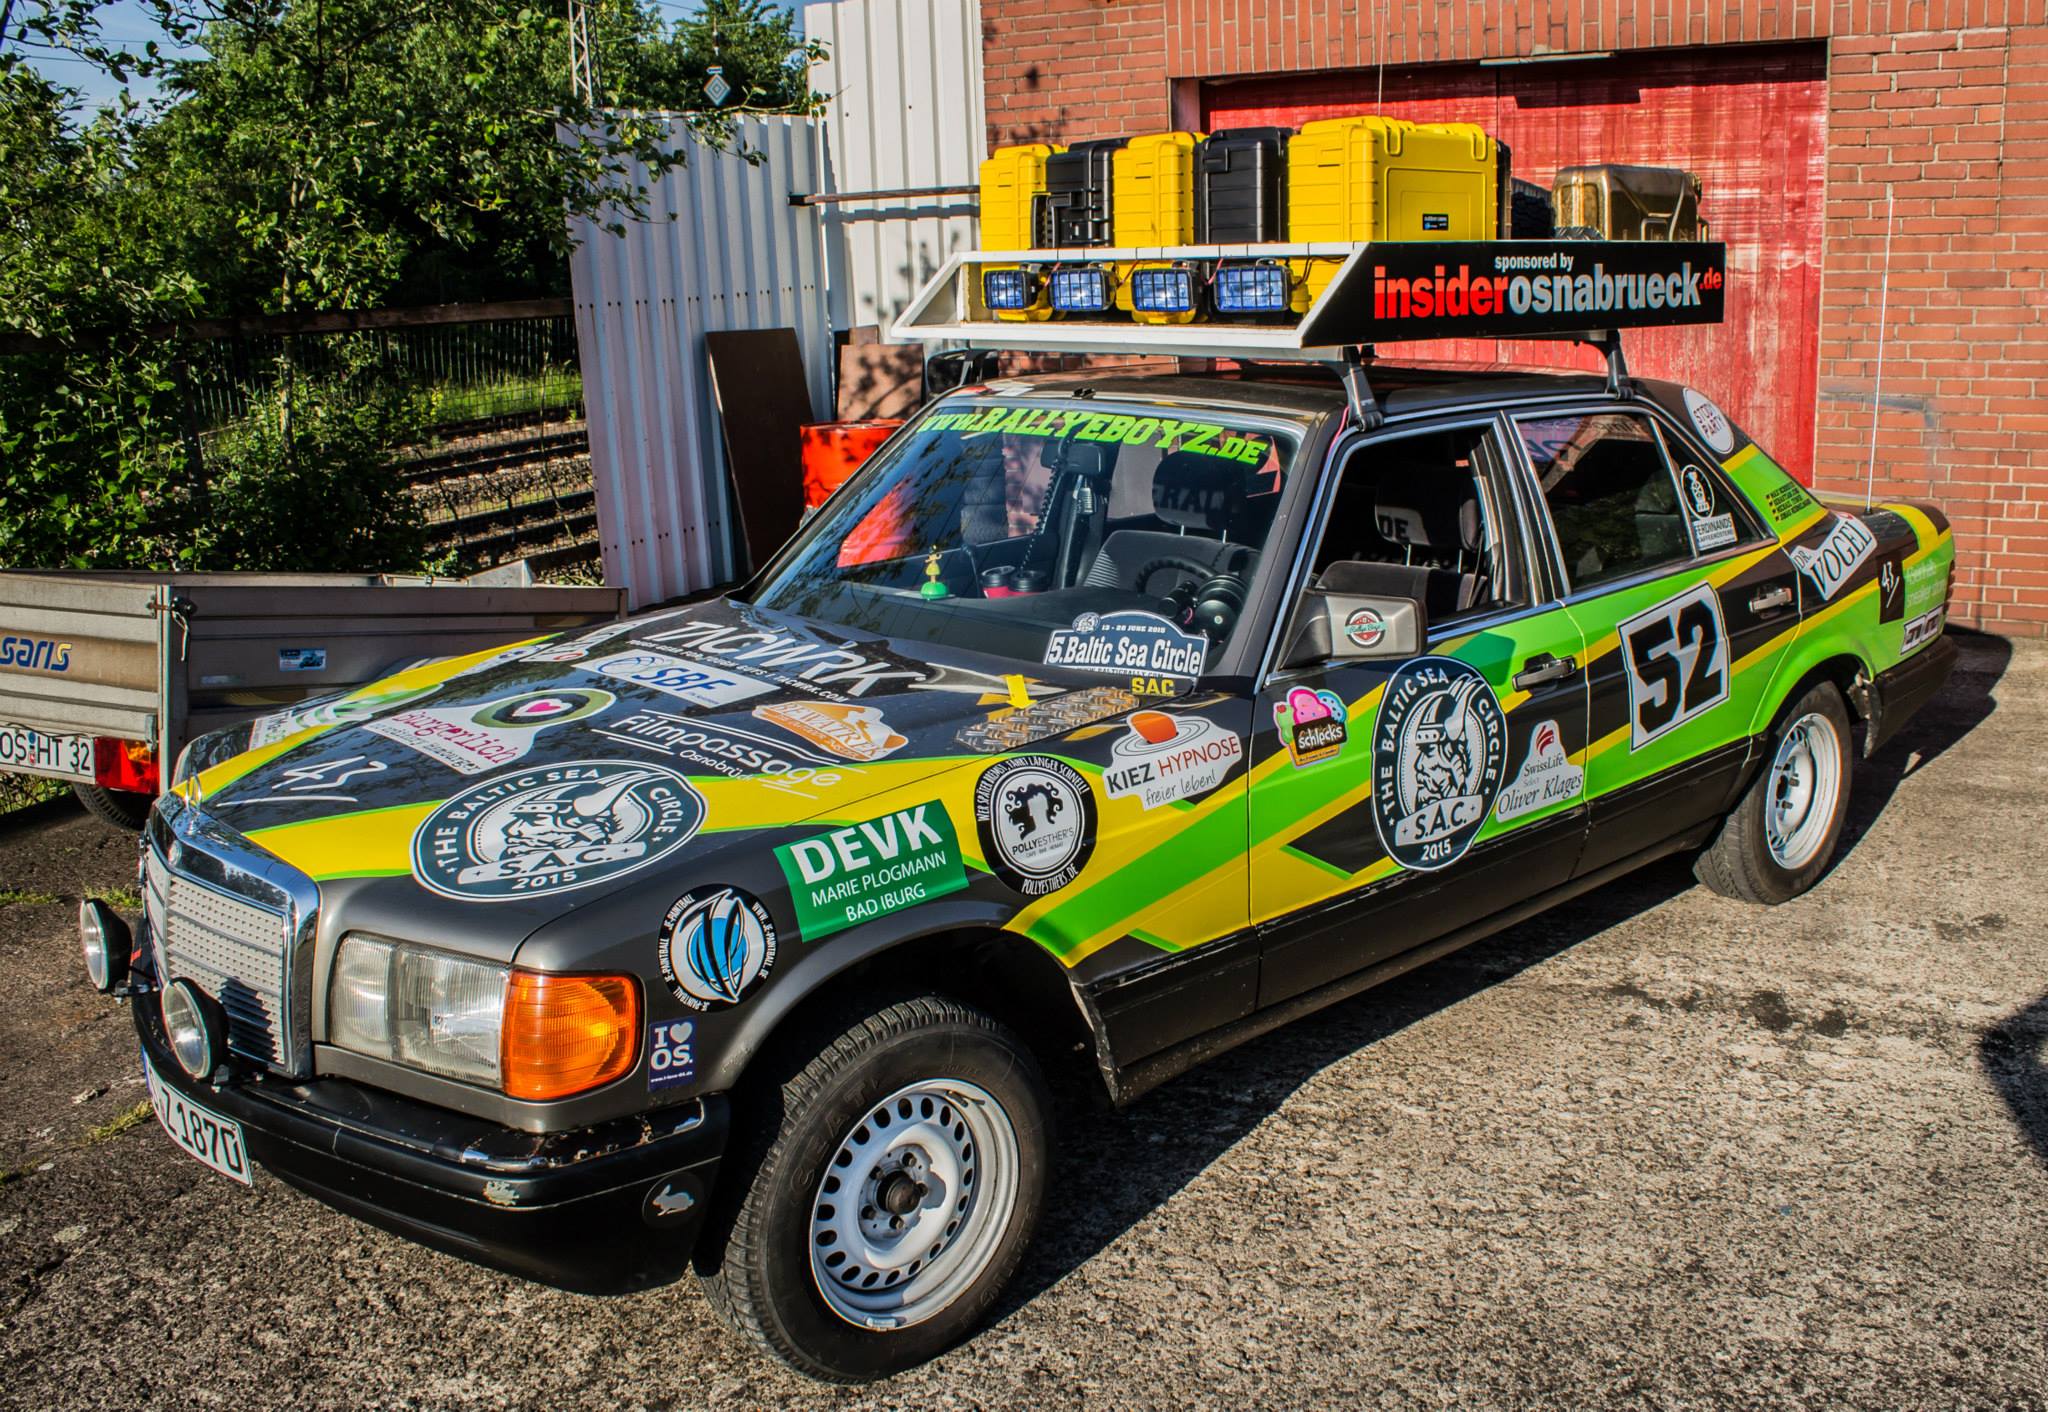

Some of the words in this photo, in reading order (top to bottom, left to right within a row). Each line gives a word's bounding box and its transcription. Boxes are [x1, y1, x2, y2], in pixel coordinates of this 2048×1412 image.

[1495, 252, 1557, 271] sponsored
[1560, 253, 1575, 272] by
[1374, 261, 1723, 319] insiderosnabrueck.de
[1702, 414, 1726, 439] PARTY
[1695, 517, 1733, 535] FERDINANDS
[1810, 521, 1873, 594] VOGEL
[1127, 624, 1146, 632] JUNE
[0, 637, 72, 671] saris
[641, 620, 927, 697] TACWRK
[1114, 636, 1148, 667] Sea
[1151, 639, 1201, 674] Circle
[1628, 599, 1723, 735] 52
[631, 667, 737, 691] SBF
[773, 675, 850, 703] TACWRK.COM
[1131, 677, 1175, 695] SAC
[1416, 667, 1449, 688] SEA
[1381, 679, 1417, 752] BALTIC
[0, 732, 27, 760] OS
[37, 736, 62, 766] HT
[69, 741, 91, 771] 32
[609, 715, 842, 787] Filmpassage
[1478, 698, 1500, 781] CIRCLE
[679, 749, 753, 781] Osnabrück
[1007, 756, 1029, 770] FÄHRT
[1029, 755, 1059, 768] LÄNGER
[1106, 762, 1155, 794] KIEZ
[1157, 736, 1240, 777] HYPNOSE
[1523, 752, 1564, 778] SwissLife
[975, 784, 995, 805] SPÄTER
[1145, 785, 1176, 806] freier
[1180, 769, 1217, 794] leben!
[1380, 765, 1396, 816] THE
[1497, 789, 1540, 815] Oliver
[1542, 774, 1583, 800] Klages
[434, 826, 460, 869] THE
[447, 777, 537, 820] BALTIC
[547, 769, 600, 782] SEA
[649, 787, 685, 835] CIRCLE
[977, 805, 991, 821] WER
[1414, 801, 1467, 841] S.A.C.
[789, 805, 943, 885] DEVK
[1011, 827, 1075, 855] POLLYESTHER'S
[1420, 838, 1451, 861] 2015
[498, 847, 613, 877] S.A.C.
[811, 878, 861, 907] MARIE
[861, 850, 946, 892] PLOGMANN
[511, 870, 577, 890] 2015
[664, 893, 695, 931] JE-PAINTBALL
[845, 900, 878, 922] BAD
[880, 883, 926, 910] IBURG
[658, 938, 675, 982] JE-PAINTBALL
[673, 986, 710, 1011] JE-PAINTBALL
[654, 1025, 668, 1049] I
[650, 1044, 693, 1071] OS.
[177, 1101, 243, 1175] 1870
